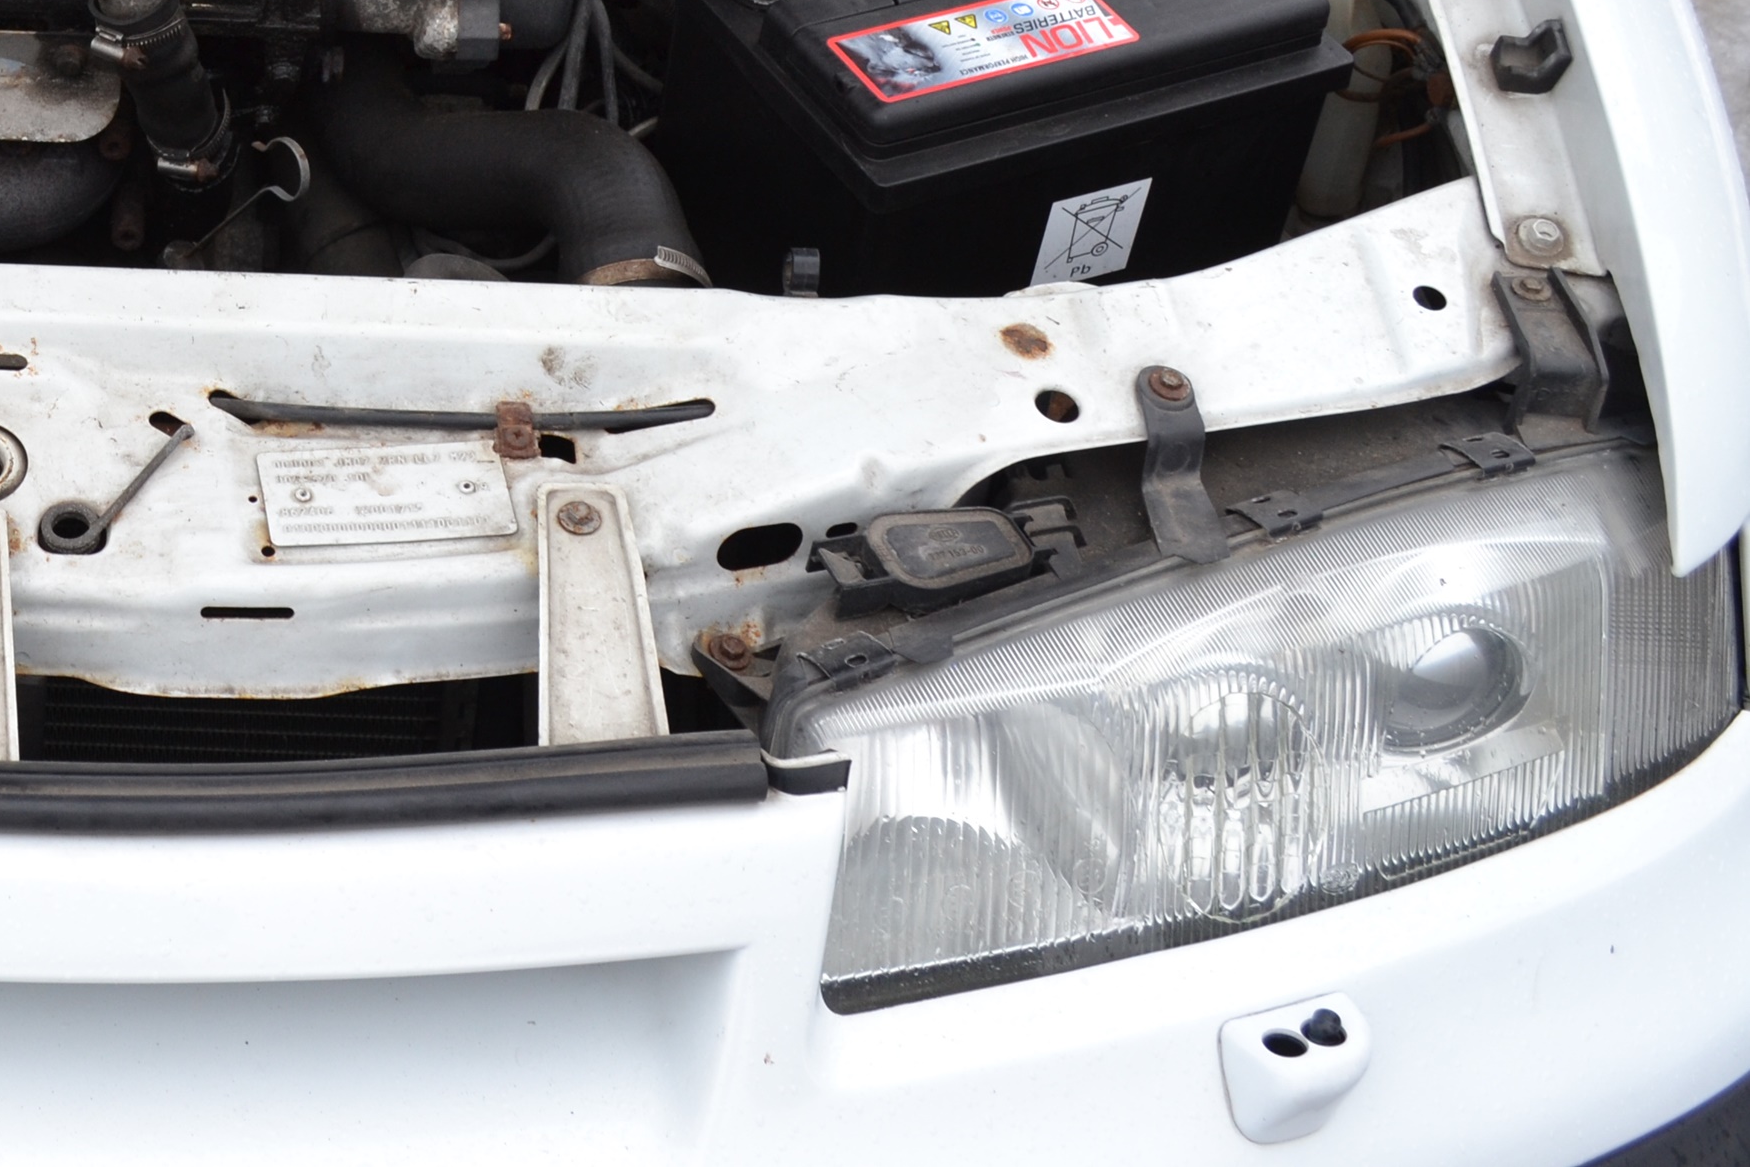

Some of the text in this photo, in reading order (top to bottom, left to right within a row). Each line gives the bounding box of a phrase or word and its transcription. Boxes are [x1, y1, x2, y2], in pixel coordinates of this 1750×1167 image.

[1013, 5, 1096, 33] BATTERIES
[1019, 17, 1115, 58] LION
[959, 58, 1012, 76] PERFORMANCE
[1069, 264, 1091, 278] Pb
